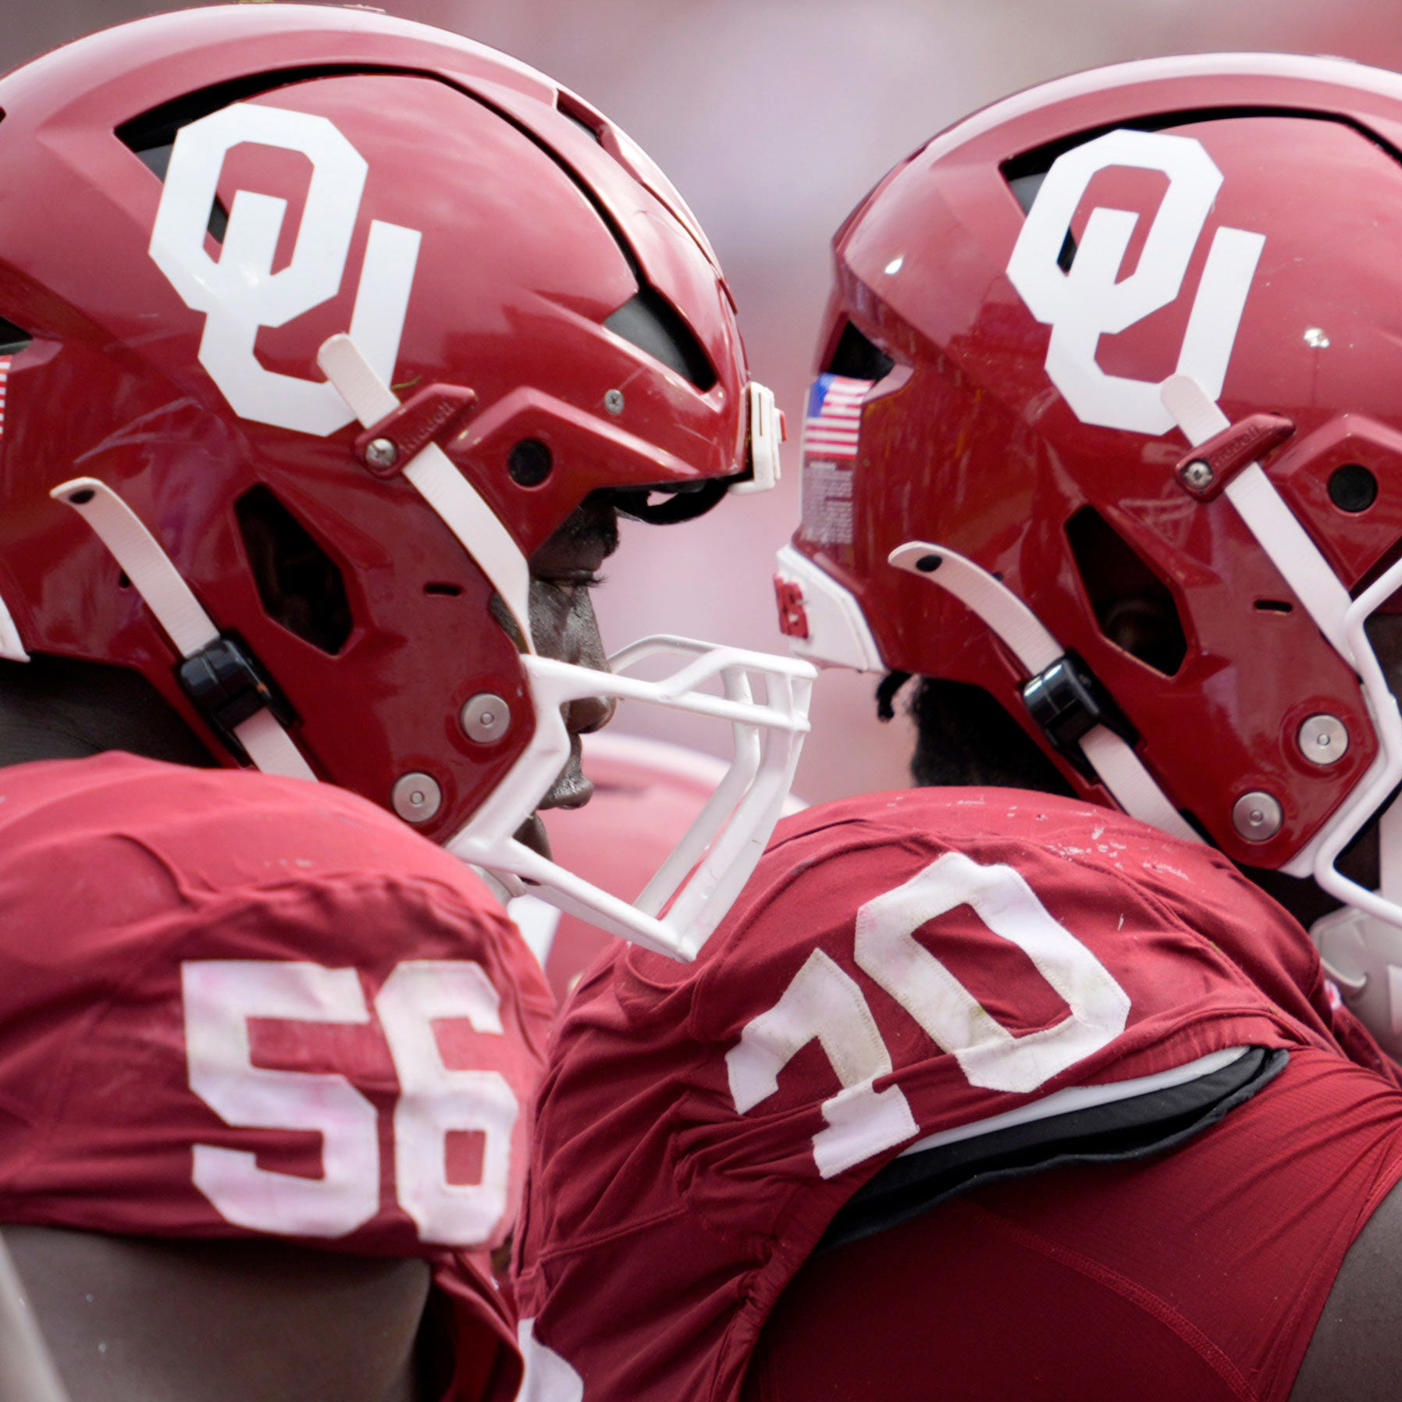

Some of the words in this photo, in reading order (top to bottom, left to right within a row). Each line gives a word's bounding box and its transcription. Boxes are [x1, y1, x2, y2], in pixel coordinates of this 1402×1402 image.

[149, 103, 421, 437] OU
[1007, 129, 1265, 436] OU
[181, 960, 520, 1247] 56
[724, 851, 1132, 1180] 70
